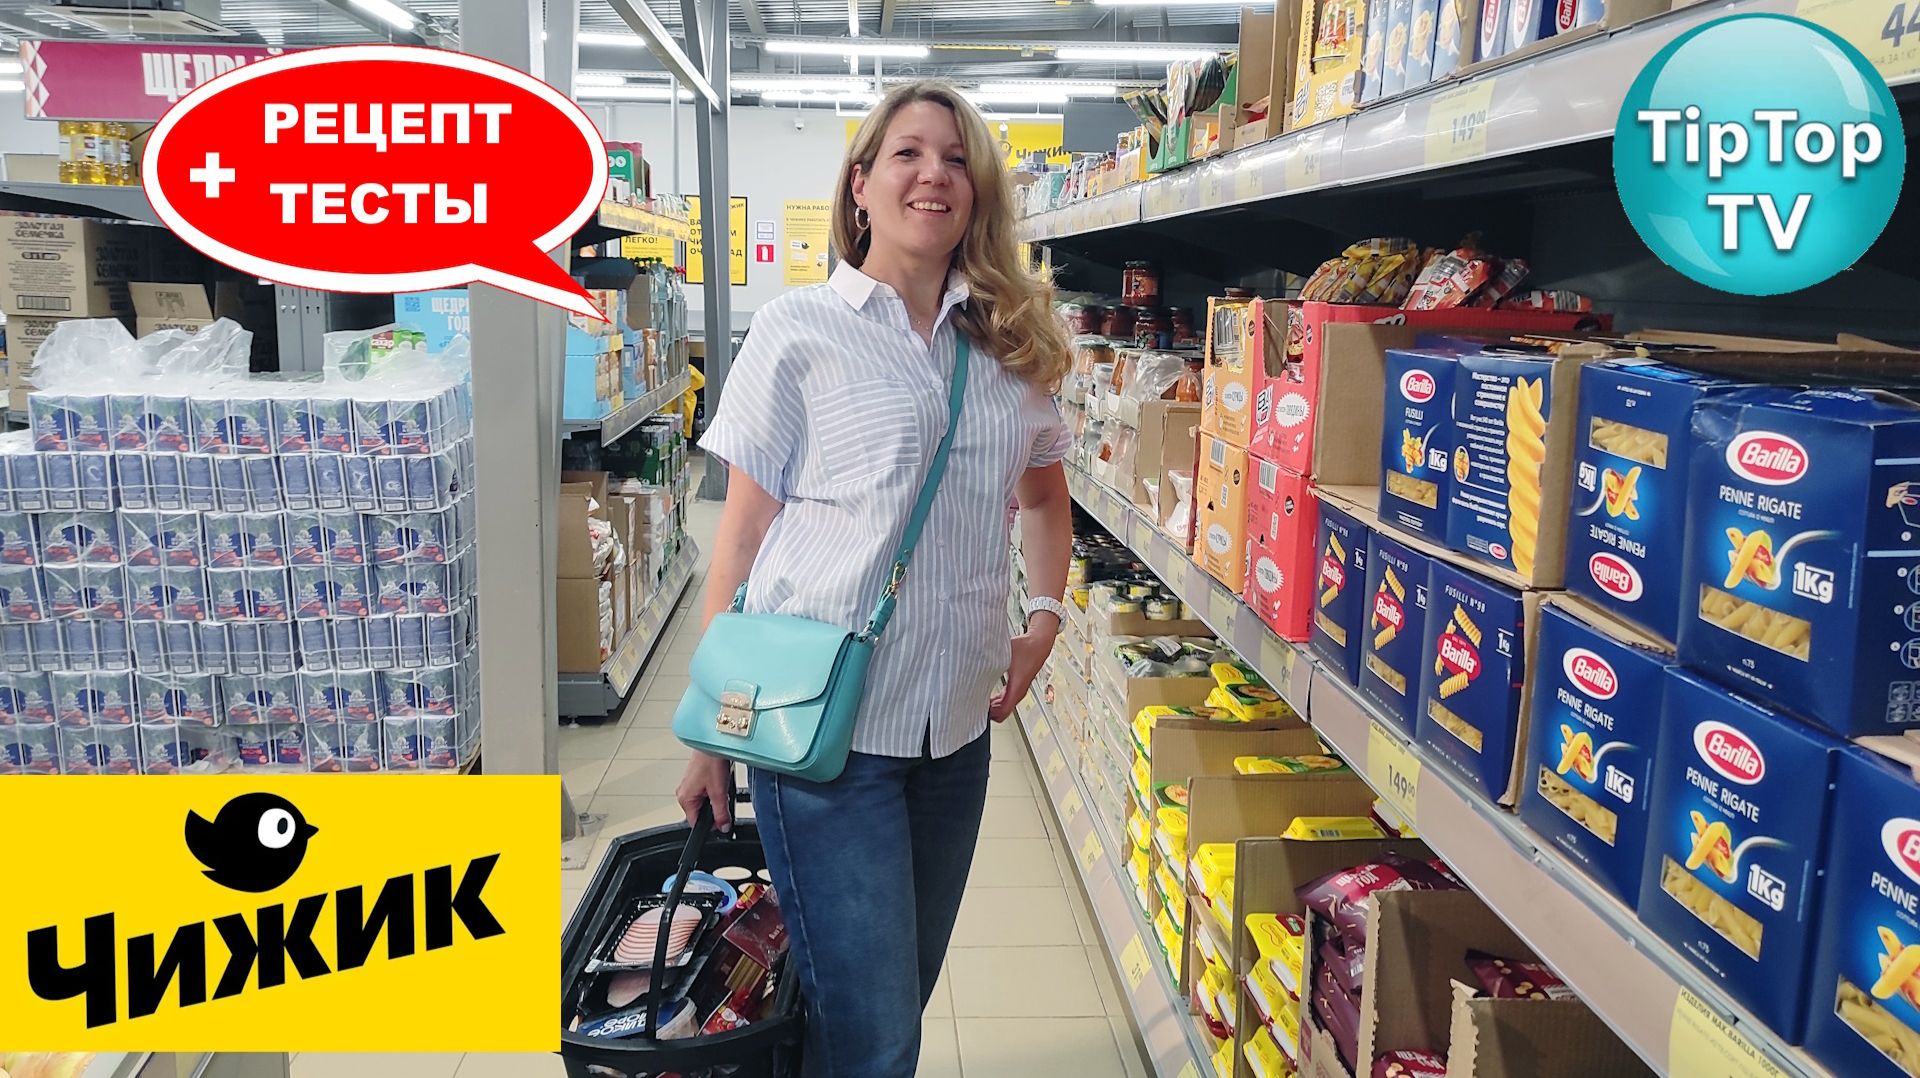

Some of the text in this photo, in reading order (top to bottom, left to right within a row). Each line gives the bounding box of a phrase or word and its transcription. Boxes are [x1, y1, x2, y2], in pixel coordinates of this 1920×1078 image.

[142, 47, 284, 103] ЩЕД
[15, 222, 64, 231] ЗОЛОТАЯ
[15, 230, 64, 239] СЕМЕЧКА
[1407, 377, 1432, 395] Barilla
[1405, 407, 1424, 420] FUSILLI
[1741, 442, 1801, 474] Barilla
[1720, 485, 1802, 520] PENNE RIGATE
[1325, 518, 1338, 531] FUSILLI
[1590, 524, 1616, 546] RIGATE
[1379, 549, 1396, 565] FUSILLI
[1617, 541, 1646, 559] PENNE
[1322, 560, 1342, 585] Barilla
[1594, 560, 1629, 591] Barilla
[1445, 584, 1468, 604] FUSILLI
[1375, 597, 1401, 626] Barilla
[1441, 638, 1475, 674] Barilla
[1573, 658, 1613, 692] Barilla
[1557, 687, 1582, 716] PENNE
[1584, 703, 1614, 731] RIGATE
[1707, 732, 1758, 776] Barilla
[1389, 764, 1407, 799] 149
[1686, 767, 1719, 798] PENNE
[1721, 787, 1760, 823] RIGATE
[1355, 871, 1380, 888] ГОД
[1871, 871, 1918, 914] PENNE
